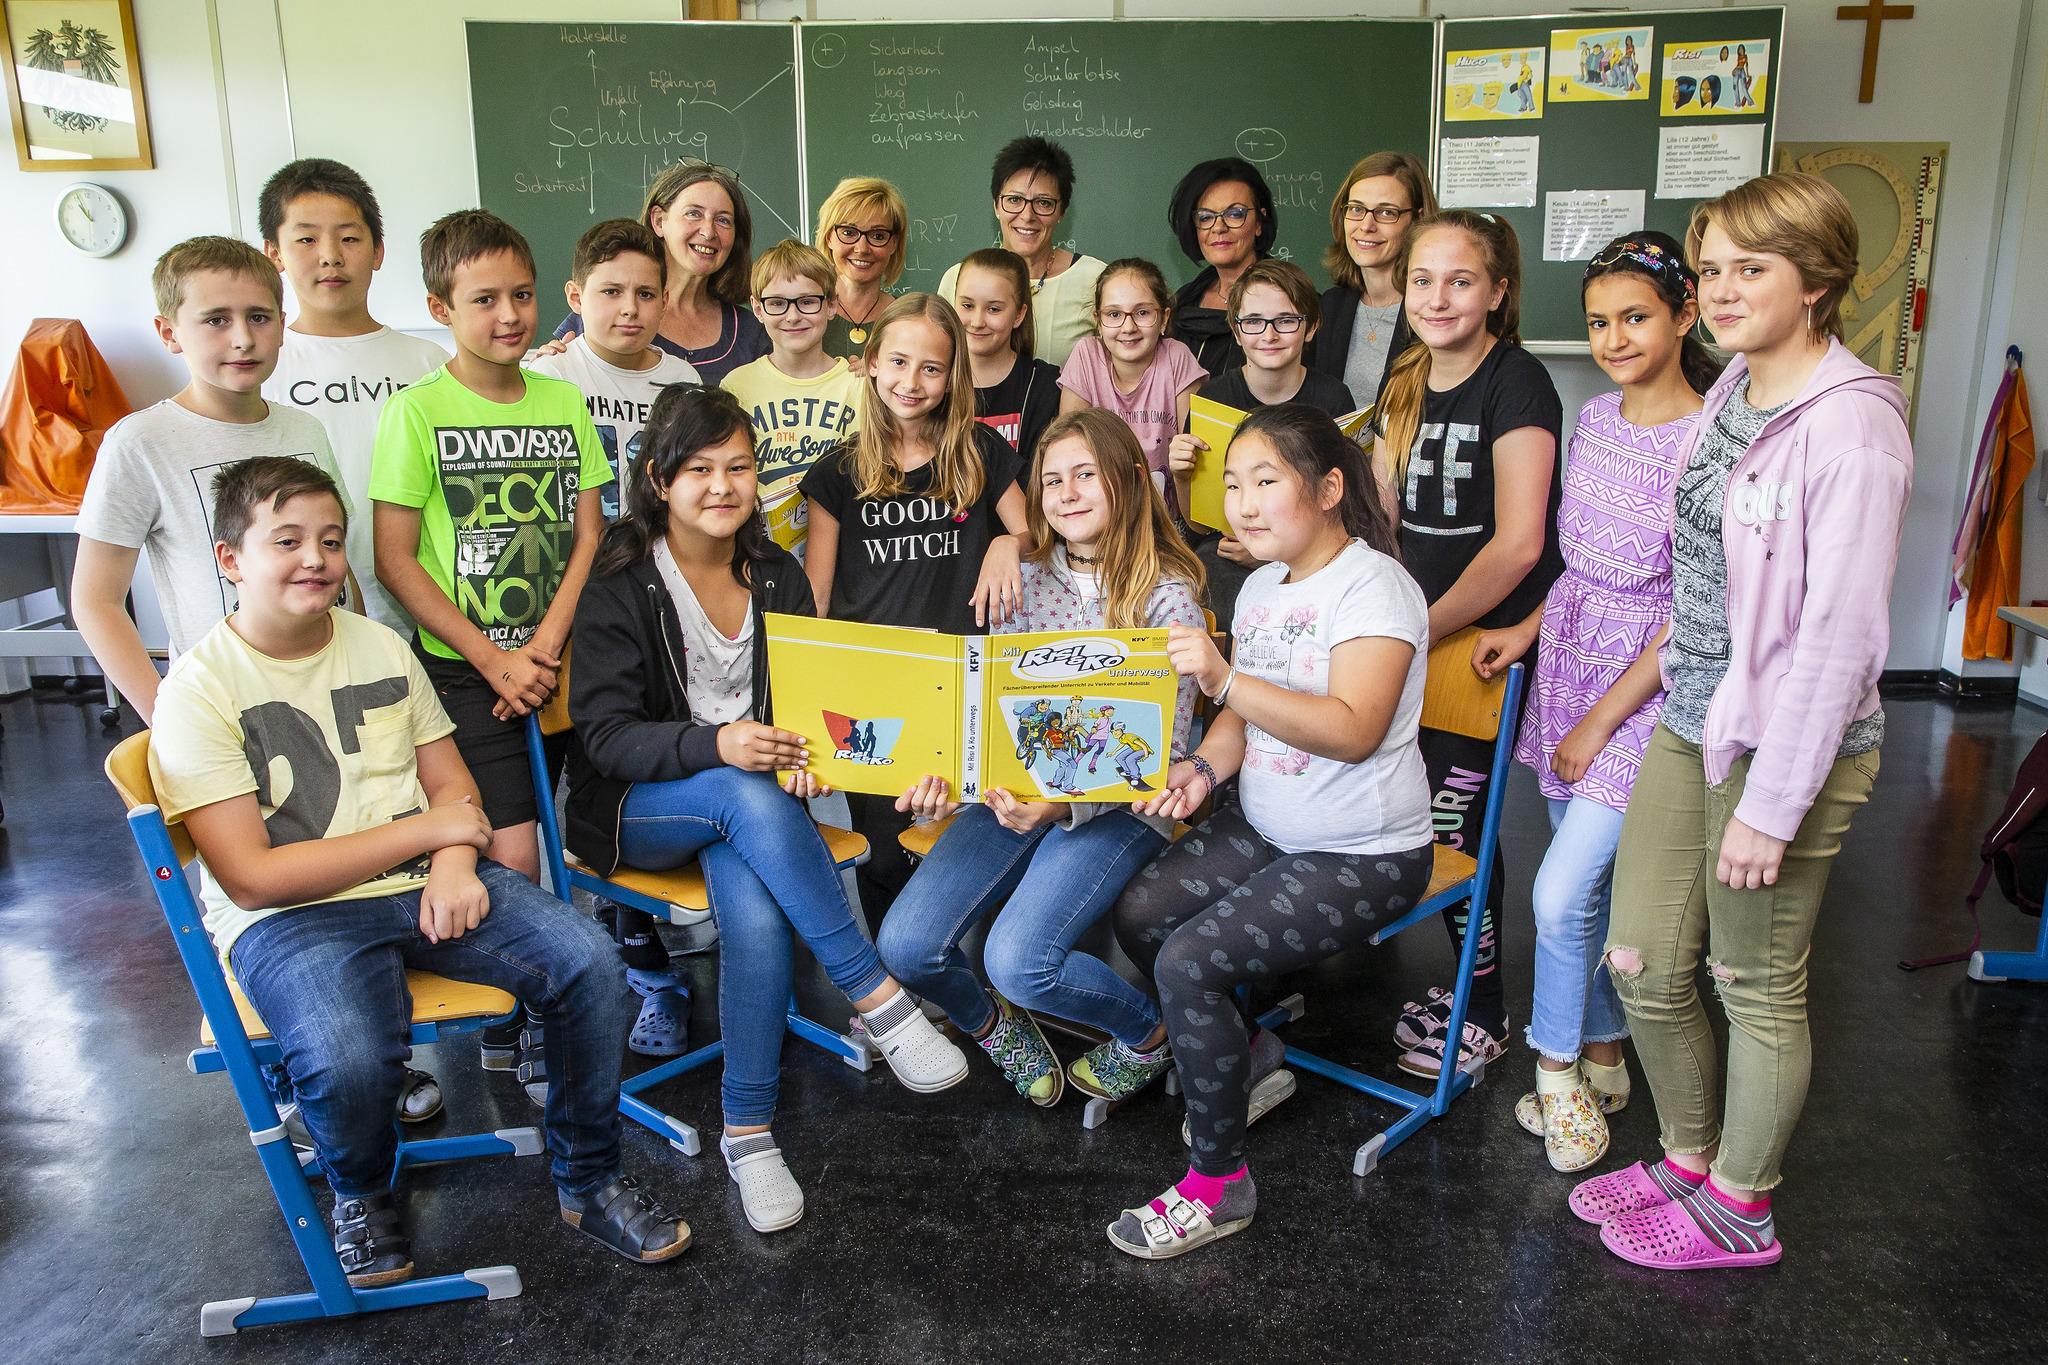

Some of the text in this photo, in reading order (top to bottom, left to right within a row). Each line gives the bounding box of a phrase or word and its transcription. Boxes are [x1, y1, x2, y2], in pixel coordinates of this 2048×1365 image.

[560, 26, 627, 44] Haltestelle
[870, 38, 945, 57] Sicherheit
[1024, 35, 1080, 61] Ampel
[600, 86, 639, 107] Unfall
[869, 91, 980, 123] Zebrastreifen
[874, 82, 906, 108] Weg
[1023, 90, 1084, 120] Gehsteig
[549, 104, 708, 164] Schulweg
[871, 123, 964, 149] aufpassen
[1024, 114, 1151, 139] Verkehrsschilder
[515, 173, 586, 193] Sicherheit
[1262, 162, 1324, 193] hrung
[587, 395, 653, 424] WHATE
[750, 398, 855, 437] MISTER
[777, 432, 797, 443] ATH.
[442, 463, 476, 471] EXPLOSION
[1384, 423, 1479, 516] FF
[861, 496, 950, 527] GOOD
[862, 530, 960, 564] WITCH
[1002, 647, 1021, 658] Mit
[1108, 666, 1169, 678] unterwegs
[1250, 645, 1278, 659] BELIEVE
[970, 705, 978, 735] unterwegs
[1432, 766, 1488, 849] CORN
[160, 867, 170, 878] 4
[298, 1217, 307, 1227] 6
